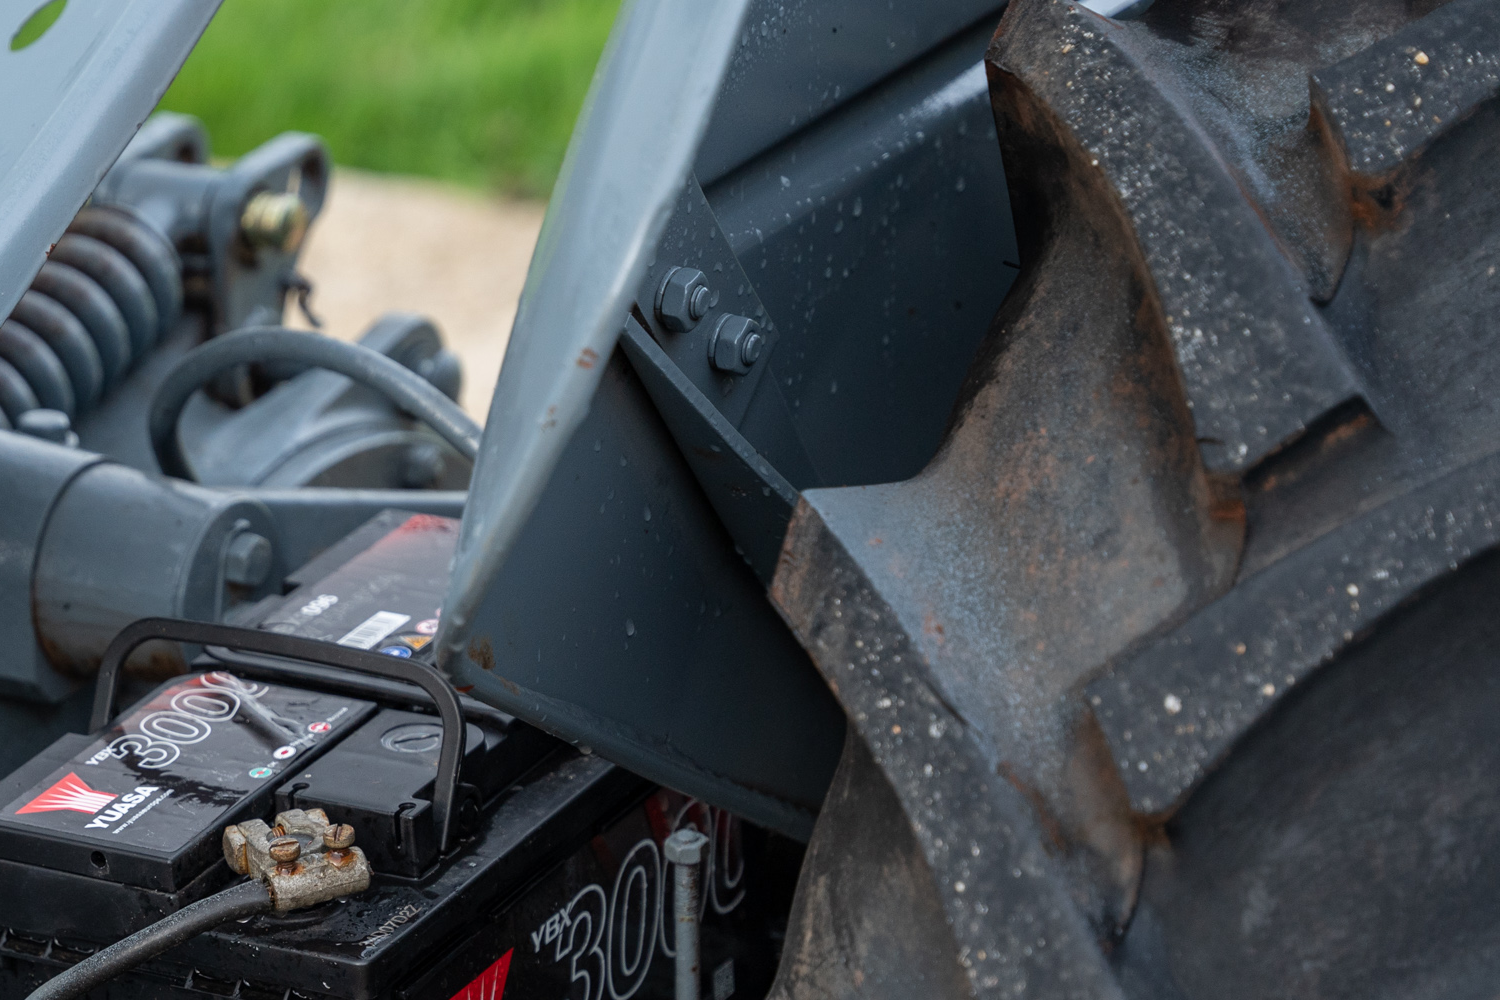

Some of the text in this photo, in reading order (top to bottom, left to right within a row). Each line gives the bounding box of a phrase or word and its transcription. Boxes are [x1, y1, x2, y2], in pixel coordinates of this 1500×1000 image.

[85, 745, 117, 766] YBX
[84, 786, 159, 829] YUASA
[531, 902, 573, 953] YBX
